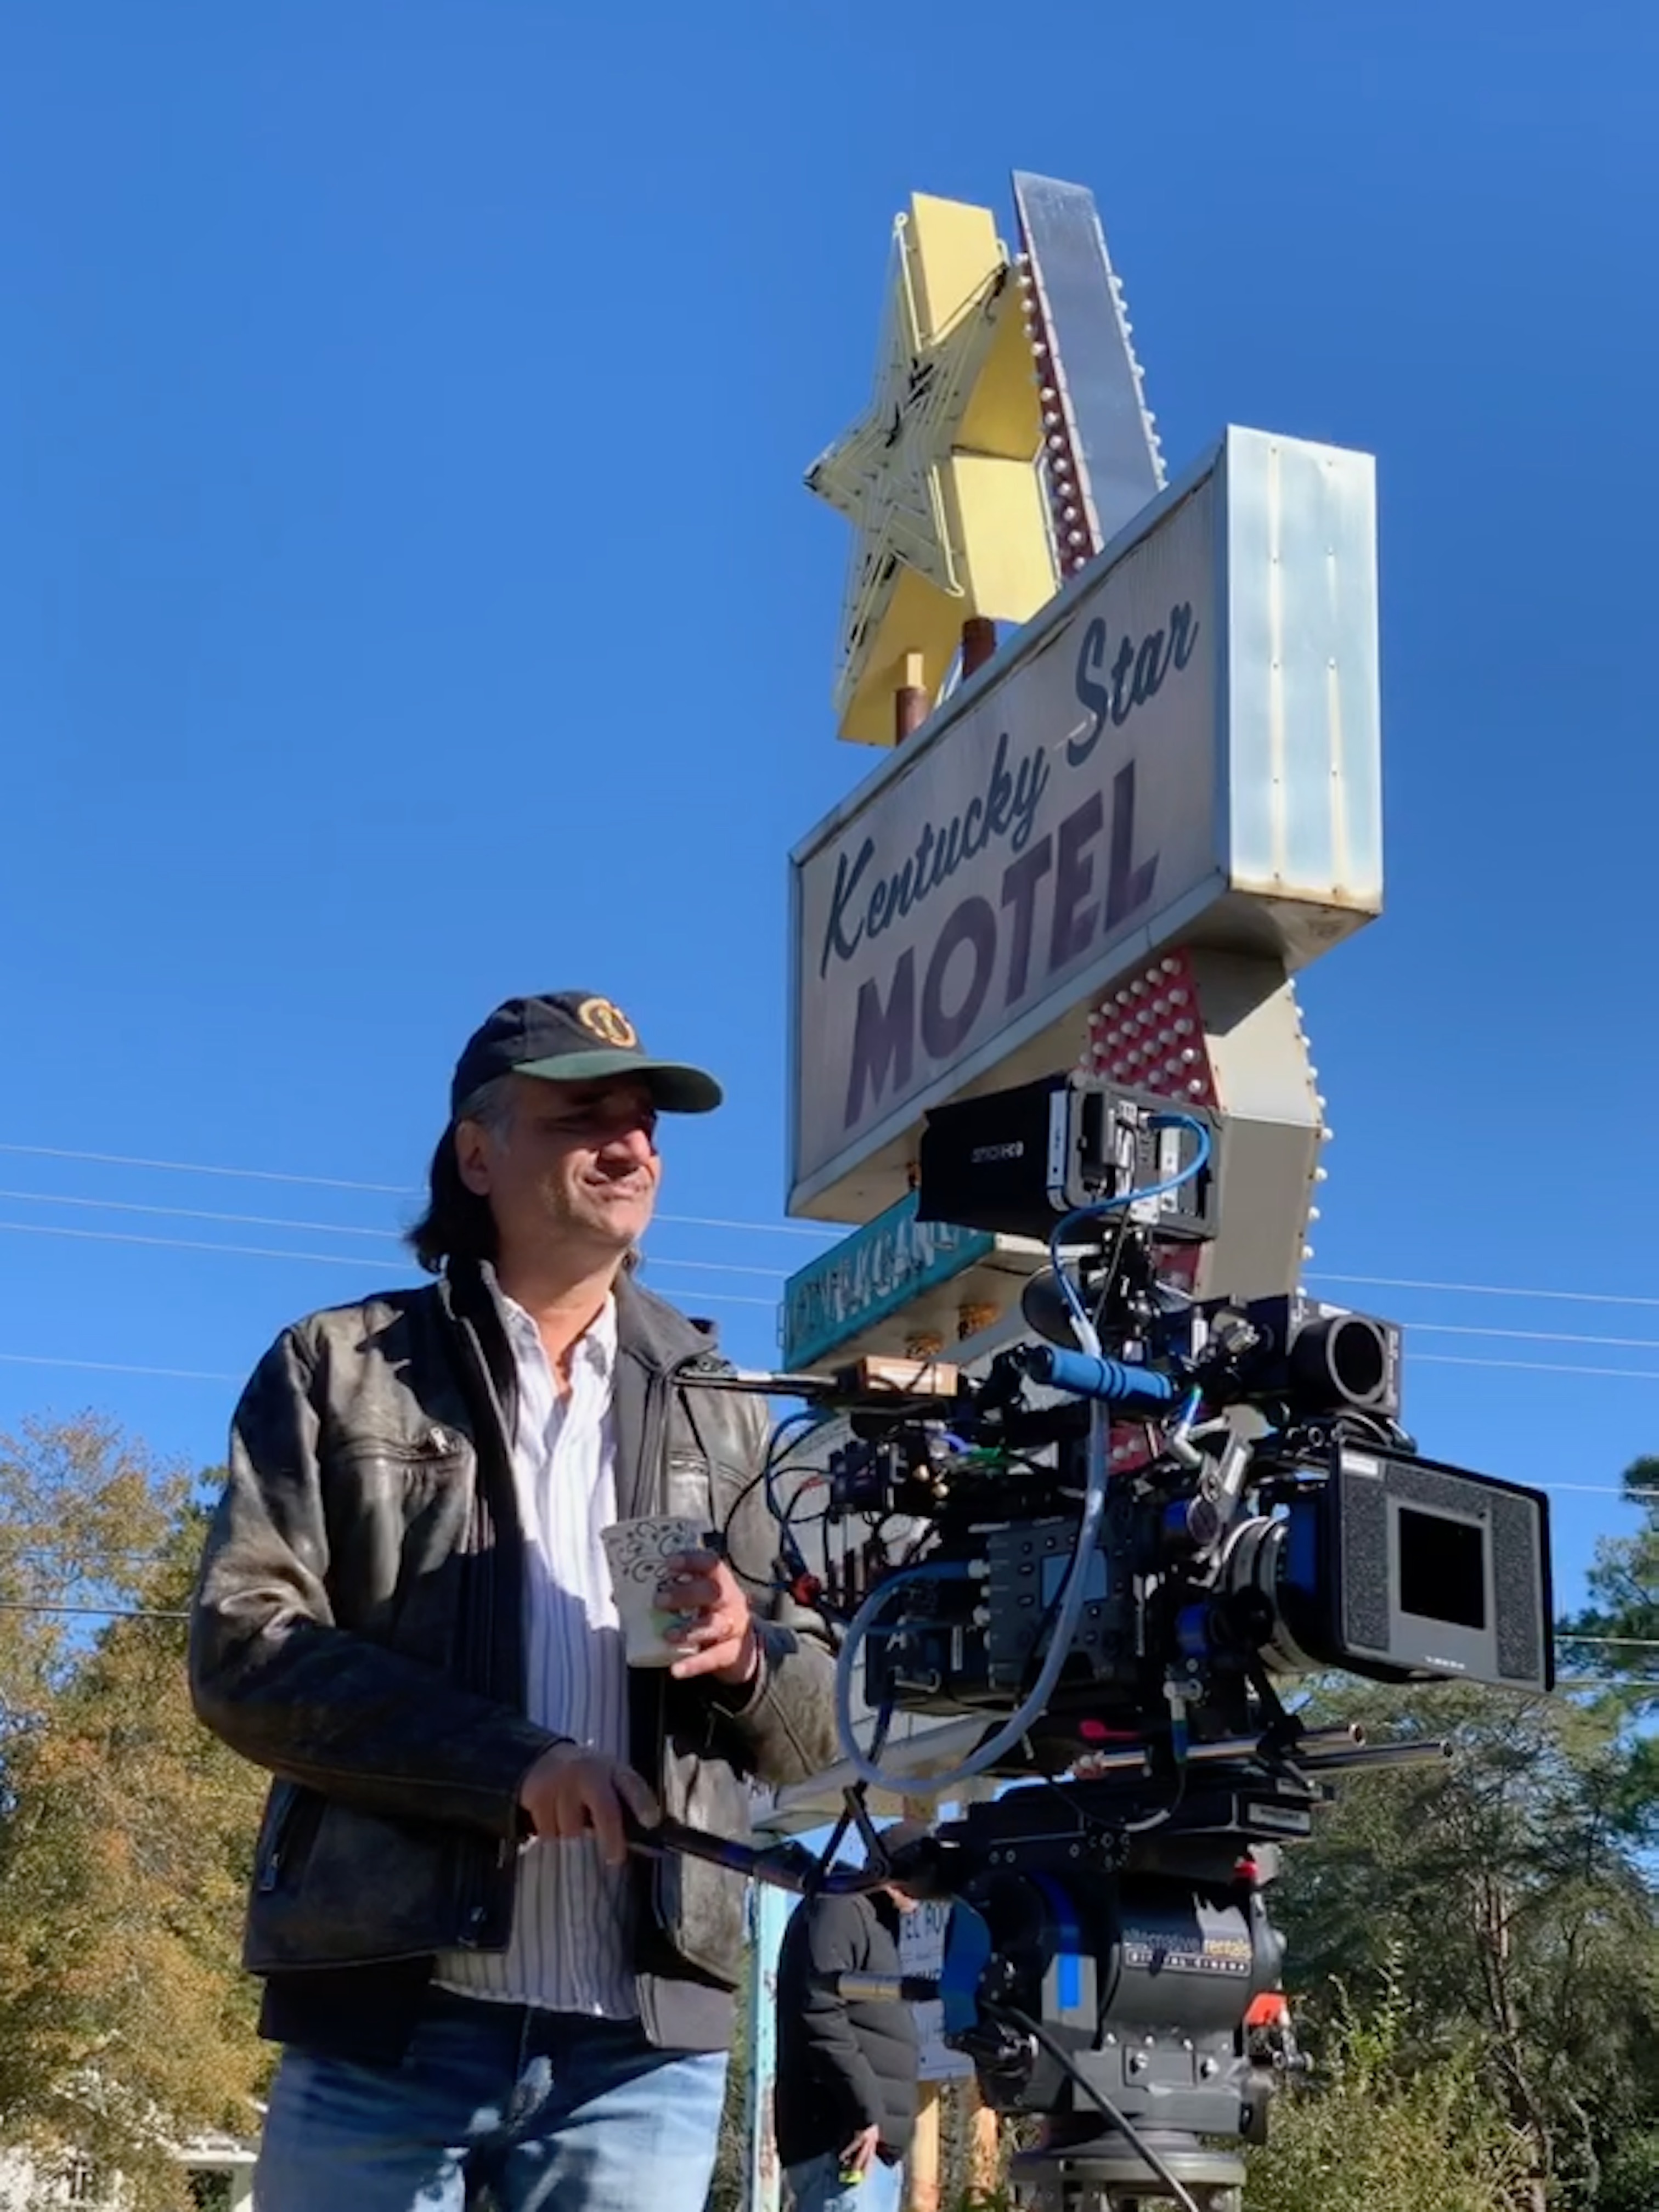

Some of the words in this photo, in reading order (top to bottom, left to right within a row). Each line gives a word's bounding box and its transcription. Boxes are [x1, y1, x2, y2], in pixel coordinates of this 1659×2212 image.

[820, 732, 1048, 979] Kentucky
[1067, 600, 1199, 768] Star
[843, 759, 1160, 1130] MOTEL
